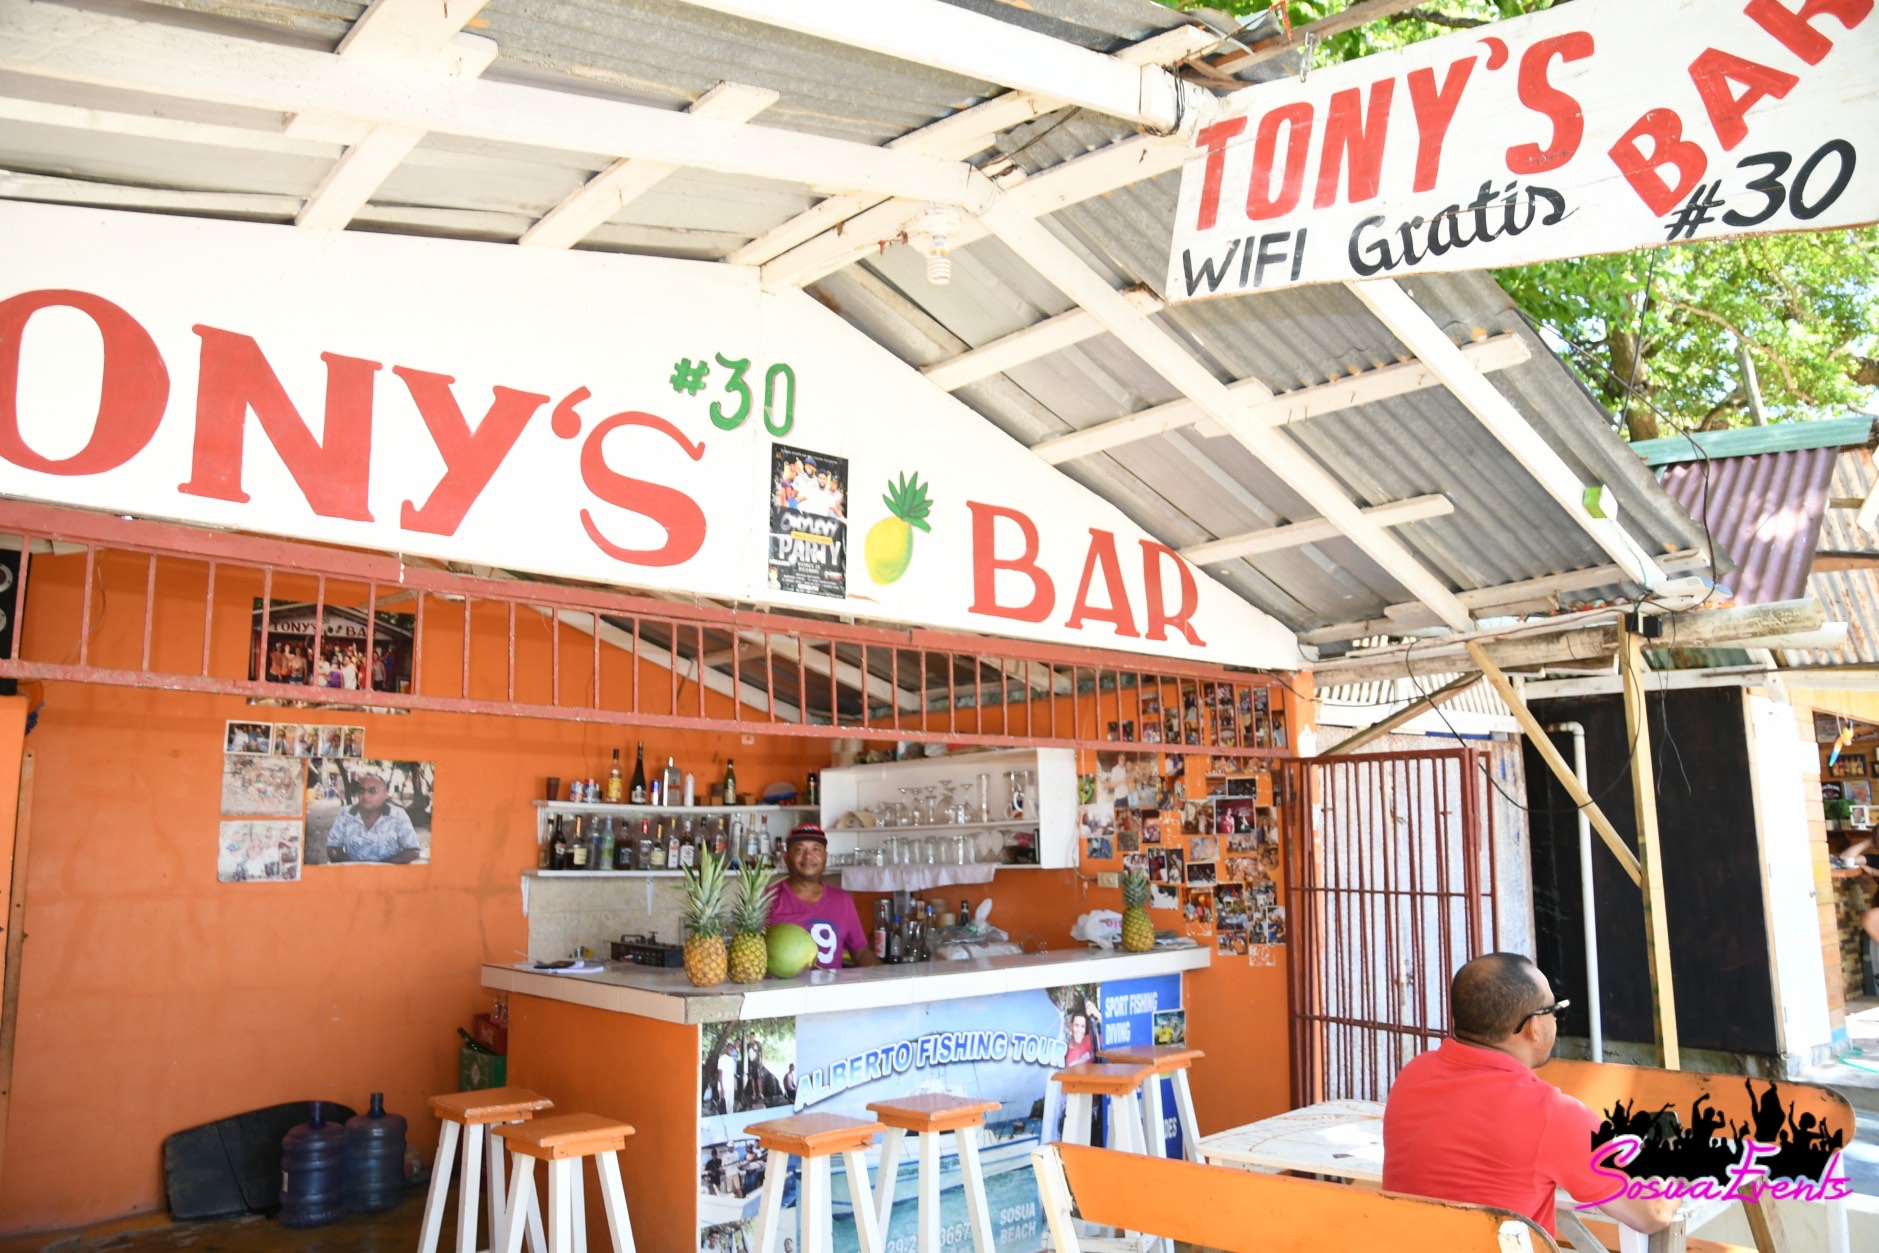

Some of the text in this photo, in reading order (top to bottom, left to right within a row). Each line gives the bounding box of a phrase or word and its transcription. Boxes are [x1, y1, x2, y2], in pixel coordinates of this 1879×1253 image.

[1196, 31, 1596, 231] TONY'S
[1663, 138, 1857, 241] #30
[1182, 178, 1582, 297] WIFI Gratis
[669, 351, 796, 438] #30
[778, 534, 842, 567] PARTY
[966, 500, 1207, 648] BAR
[810, 922, 838, 964] 9
[1105, 991, 1158, 1019] SPORT FISHING
[1105, 1020, 1132, 1046] DIVING
[793, 1030, 1068, 1112] ALBERTO FISHING TOUR
[1000, 1201, 1036, 1225] SOSUA
[1000, 1220, 1037, 1244] BEACH
